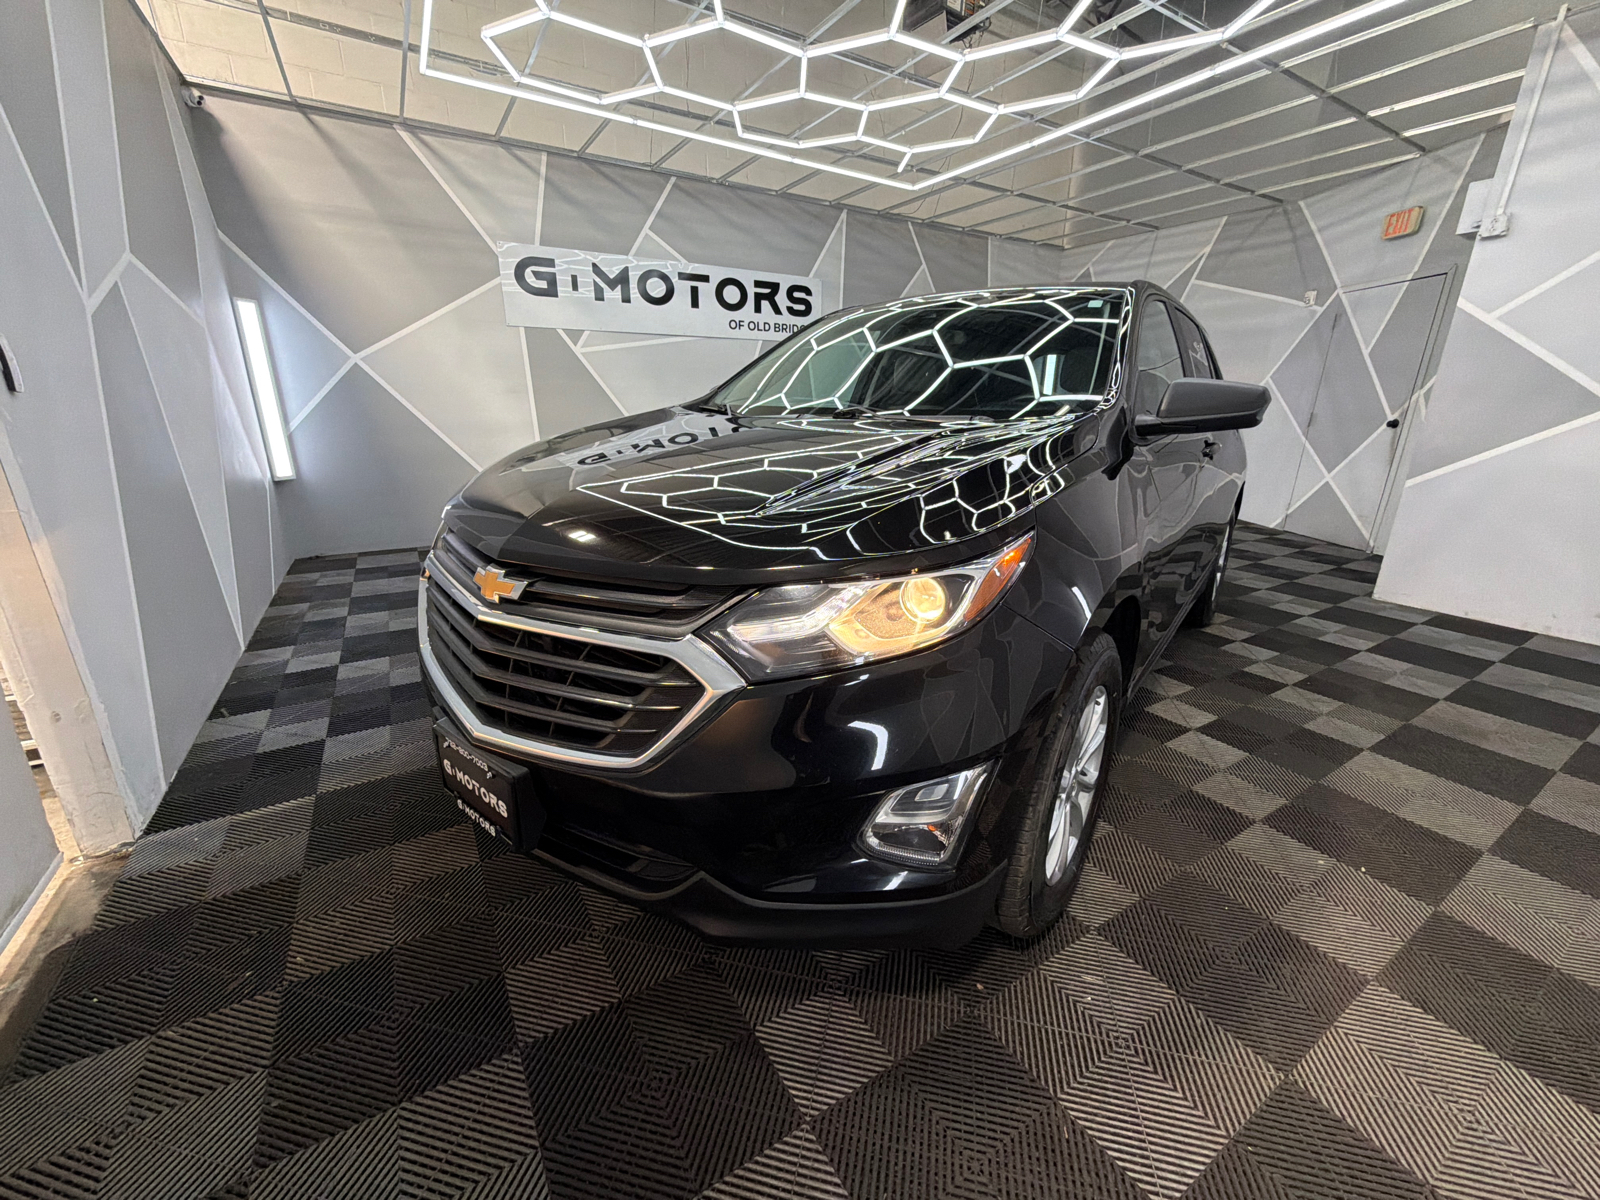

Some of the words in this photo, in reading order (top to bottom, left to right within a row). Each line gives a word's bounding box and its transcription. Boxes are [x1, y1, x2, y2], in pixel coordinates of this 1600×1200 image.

[728, 319, 745, 331] OF
[747, 320, 771, 332] OLD
[773, 322, 807, 334] BRID
